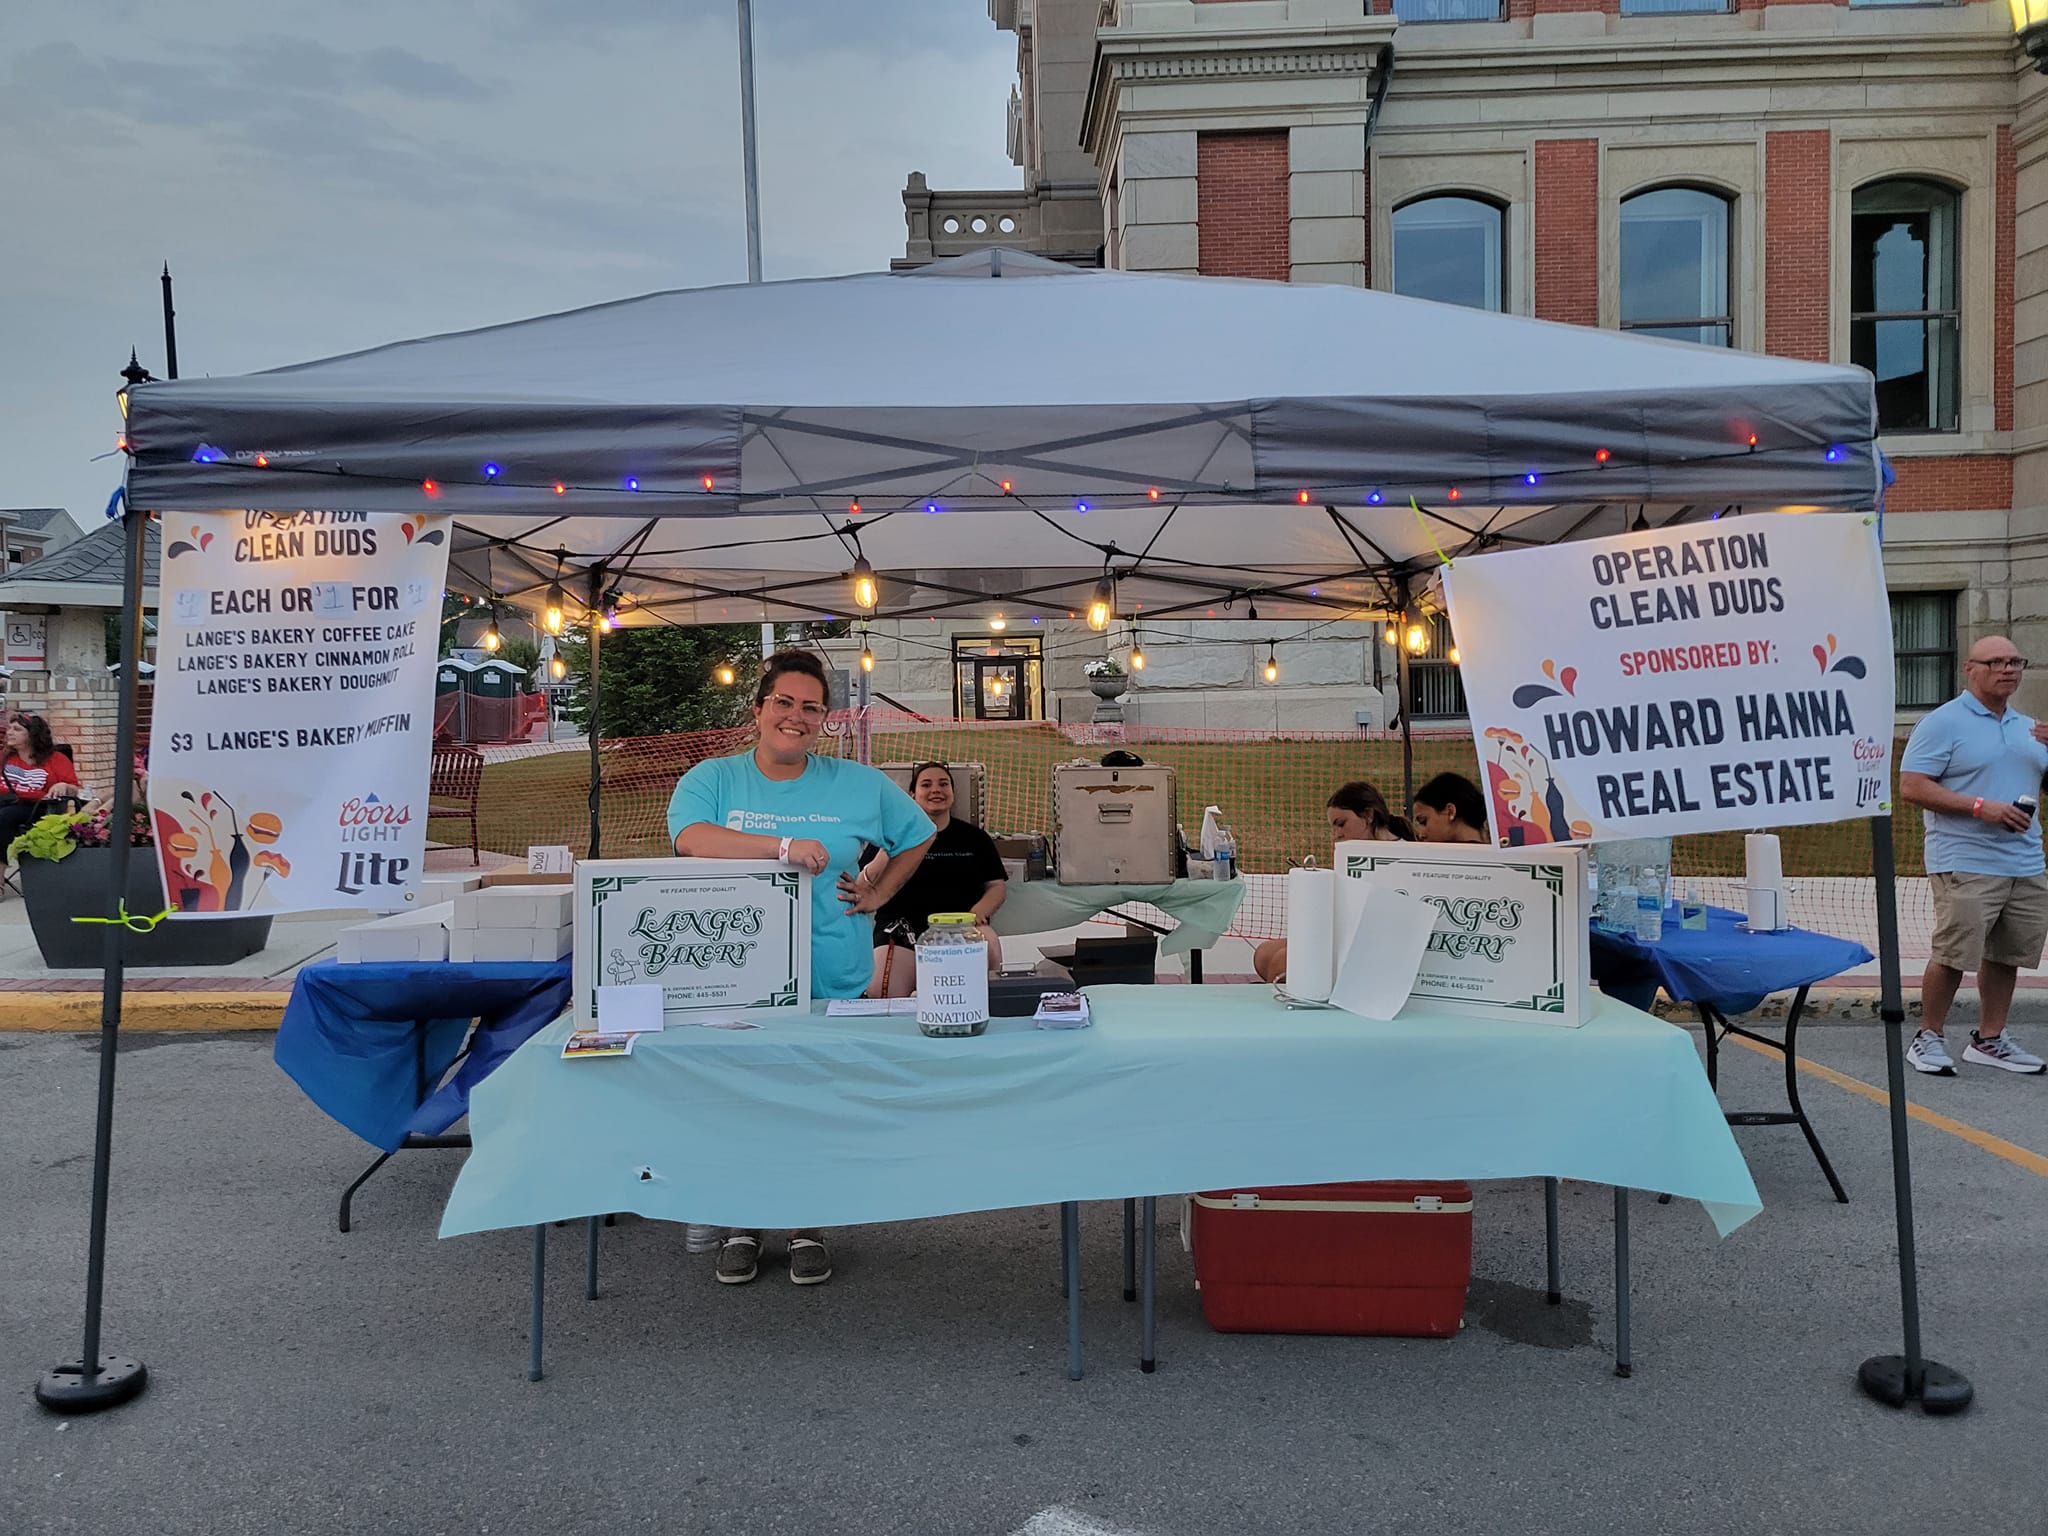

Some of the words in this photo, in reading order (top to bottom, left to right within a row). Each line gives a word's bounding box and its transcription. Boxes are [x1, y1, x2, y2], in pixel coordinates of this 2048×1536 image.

[234, 531, 304, 562] CLEAN
[314, 528, 378, 556] DUDS
[1592, 532, 1769, 586] OPERATION
[210, 588, 271, 615] EACH
[281, 587, 313, 612] OR
[352, 586, 399, 611] FOR
[1589, 584, 1701, 630] CLEAN
[1712, 577, 1785, 617] DUDS
[186, 630, 246, 648] LANGE'S
[252, 628, 315, 645] BAKERY
[323, 626, 382, 643] COFFEE
[387, 621, 416, 640] CAKE
[177, 655, 238, 671] LANGE'S
[243, 653, 308, 669] BAKERY
[315, 649, 391, 667] CINNAMON
[393, 642, 416, 662] ROLL
[1619, 642, 1742, 677] SPONSORED
[1746, 640, 1779, 666] BY:
[197, 678, 261, 695] LANGE'S
[267, 676, 333, 692] BAKERY
[340, 668, 400, 690] DOUGHNUT
[171, 732, 193, 752] $3
[207, 729, 290, 751] LANGE'S
[296, 725, 365, 747] BAKERY
[364, 713, 411, 739] MUFFIN
[1543, 697, 1724, 761] HOWARD
[1735, 688, 1855, 743] HANNA
[1854, 738, 1885, 760] Coors
[1598, 765, 1701, 819] REAL
[1710, 756, 1834, 809] ESTATE
[1856, 777, 1881, 808] Lite
[339, 797, 412, 827] Coors
[744, 811, 806, 823] Operation
[808, 814, 841, 823] Clean
[744, 820, 777, 830] Duds
[342, 826, 402, 842] LIGHT
[334, 852, 409, 895] Lite
[628, 904, 766, 943] LANGE'S
[1420, 895, 1525, 933] NGE'S
[639, 940, 758, 977] BAKERY
[924, 948, 962, 956] Operation
[1425, 930, 1517, 963] KERY
[933, 975, 966, 987] FREE
[1421, 979, 1449, 988] PHONE:
[1451, 982, 1483, 991] 445-5531
[667, 992, 695, 1000] PHONE:
[933, 993, 967, 1005] WILL
[921, 1009, 982, 1024] DONATION
